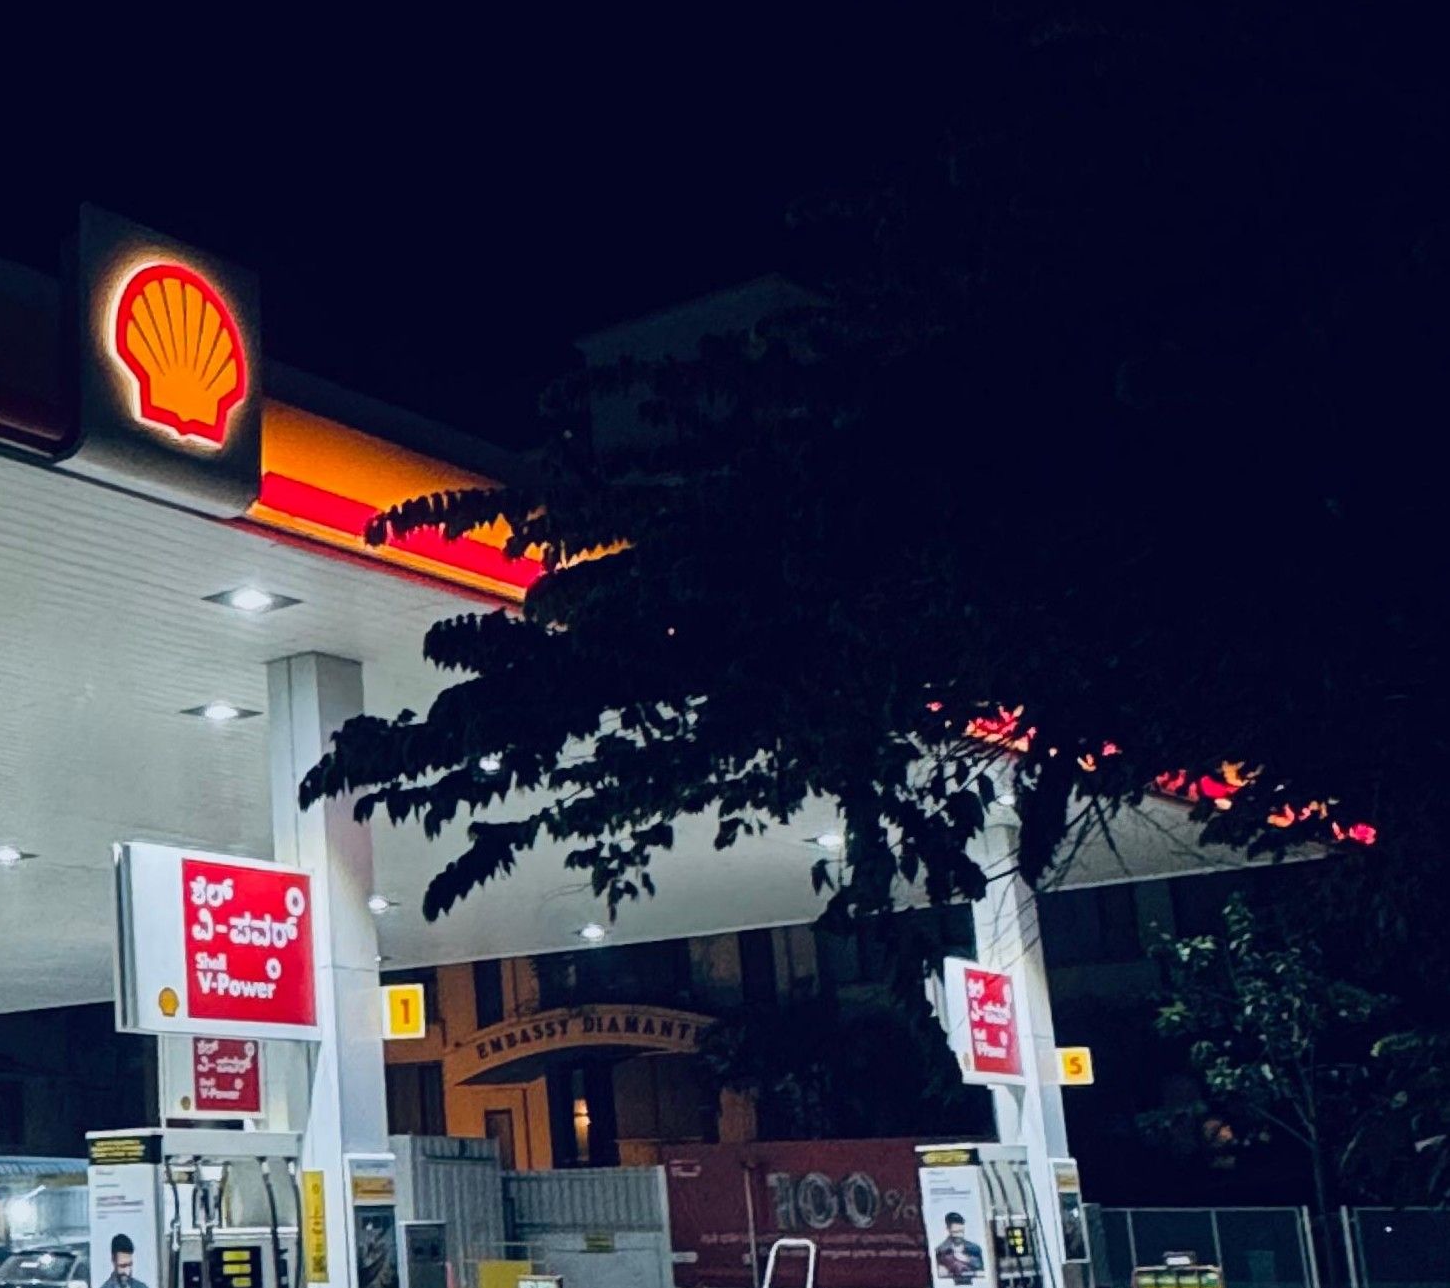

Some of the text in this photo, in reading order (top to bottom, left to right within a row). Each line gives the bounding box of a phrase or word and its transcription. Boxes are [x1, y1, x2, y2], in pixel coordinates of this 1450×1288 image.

[195, 952, 227, 971] Shell
[196, 971, 276, 999] V-Power
[400, 998, 410, 1025] 1
[476, 1019, 570, 1059] EMBASSY
